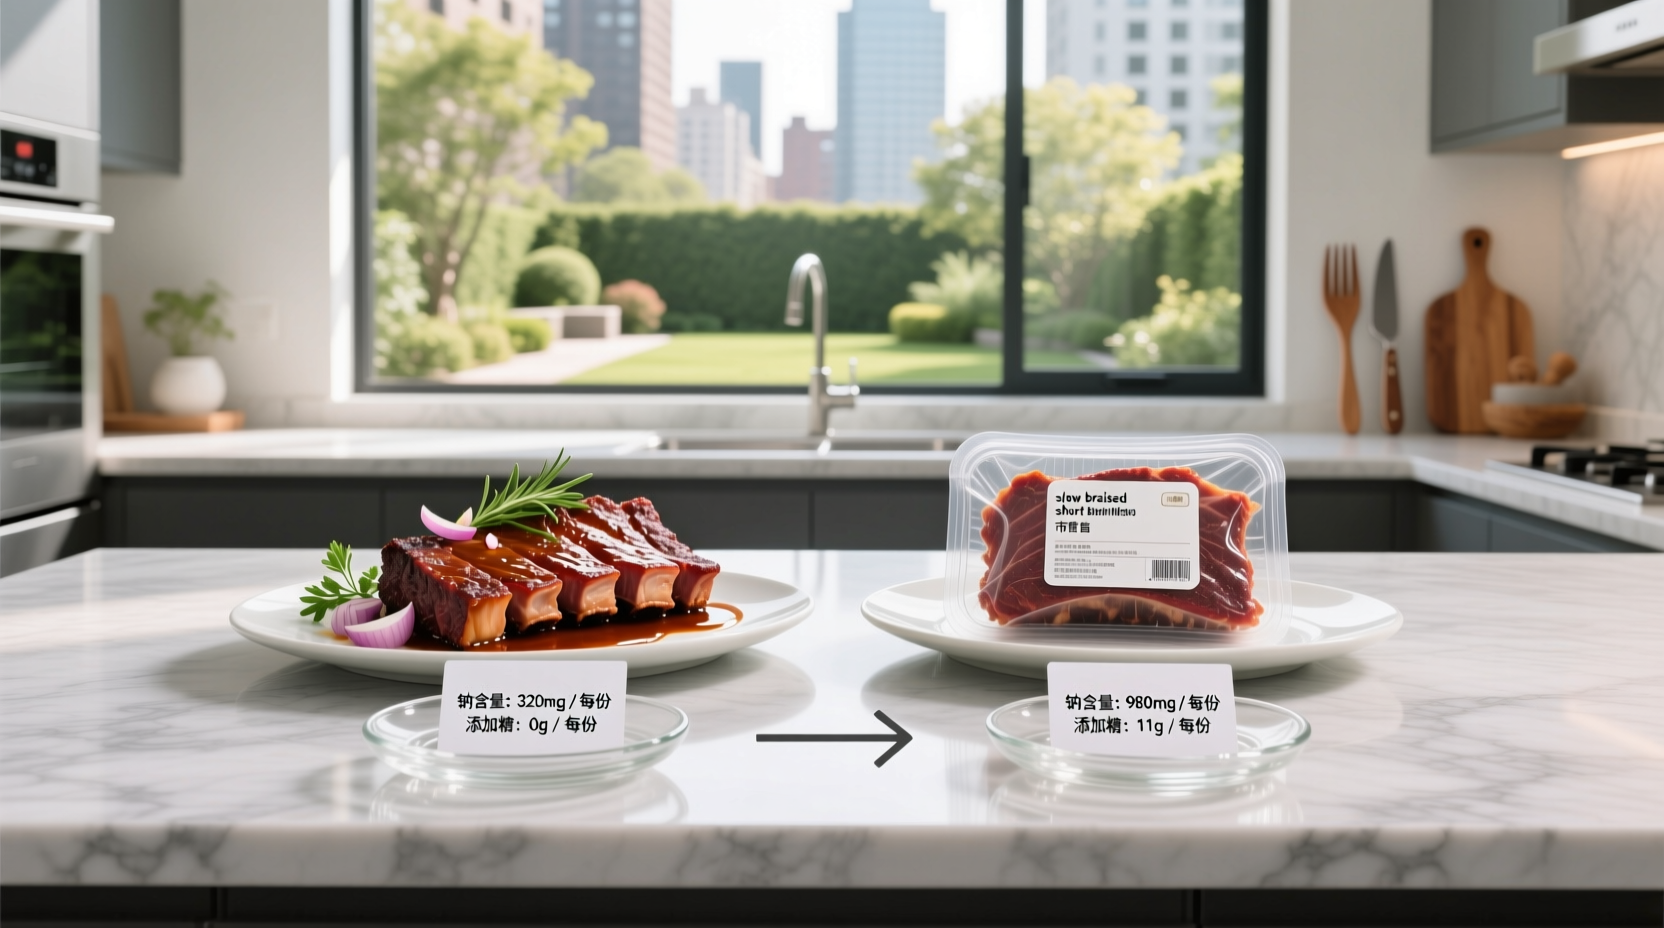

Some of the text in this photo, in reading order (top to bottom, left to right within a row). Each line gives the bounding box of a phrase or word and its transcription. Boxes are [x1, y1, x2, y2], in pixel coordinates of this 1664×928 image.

[1085, 491, 1127, 503] braised
[1055, 504, 1084, 516] short
[517, 694, 566, 712] 320mg
[1125, 695, 1176, 713] 980mg
[528, 717, 548, 736] 0g
[564, 715, 598, 733] 每份
[1137, 718, 1164, 737] 11g
[1178, 716, 1211, 734] 每份
